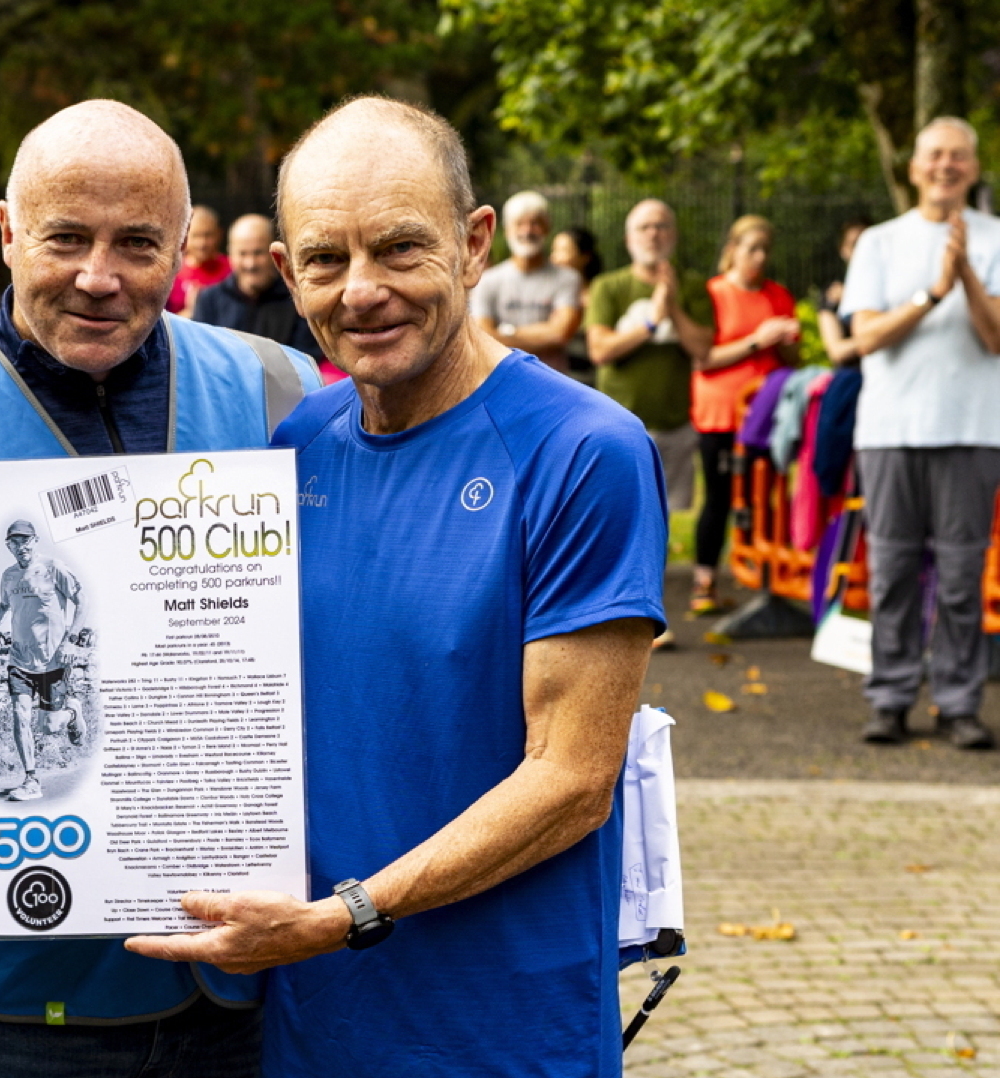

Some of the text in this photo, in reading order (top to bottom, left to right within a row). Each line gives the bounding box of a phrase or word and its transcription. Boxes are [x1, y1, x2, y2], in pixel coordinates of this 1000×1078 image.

[134, 466, 281, 528] parkrun
[139, 519, 291, 562] 500 Club!
[149, 563, 262, 577] Congratulations on
[130, 575, 282, 592] completing 500 parkruns!!
[164, 597, 249, 612] Matt Shields
[168, 615, 246, 628] September 2024
[32, 893, 59, 907] 100
[16, 908, 64, 927] VOLUNTEER
